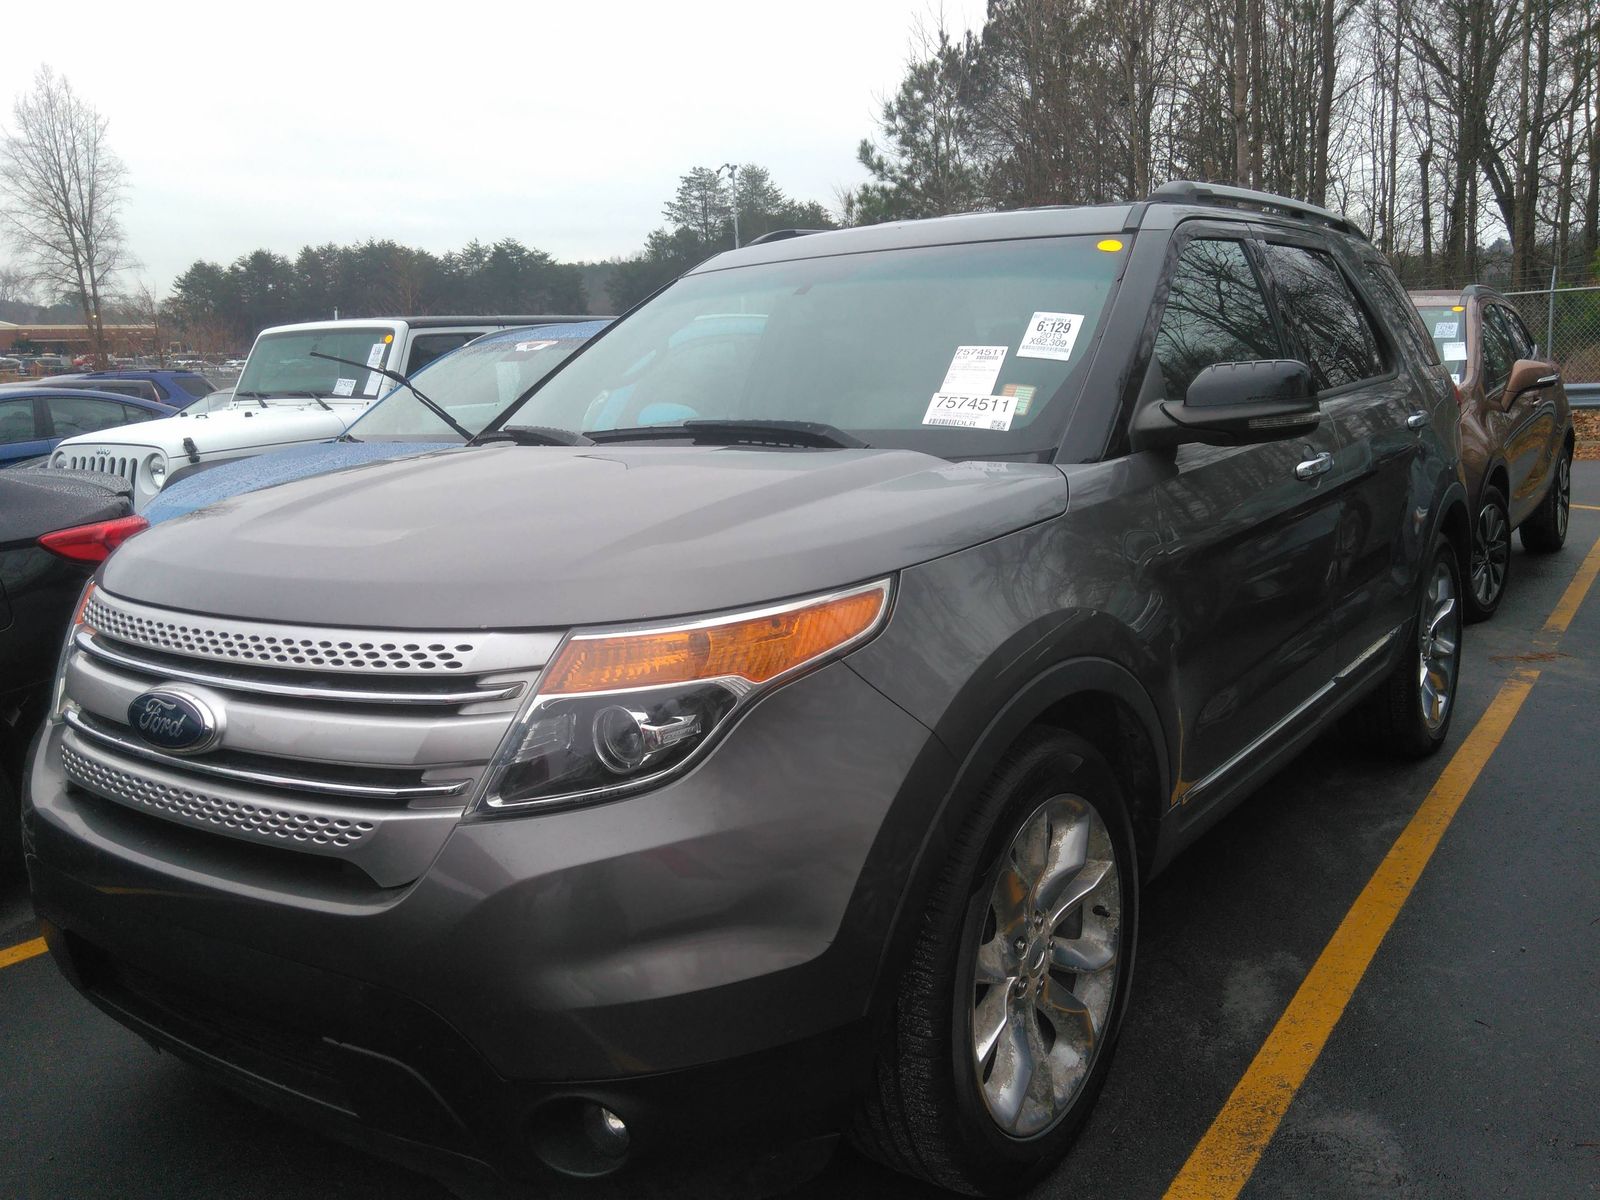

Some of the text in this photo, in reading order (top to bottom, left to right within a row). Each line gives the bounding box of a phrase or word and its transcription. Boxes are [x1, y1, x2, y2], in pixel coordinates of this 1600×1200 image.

[1036, 320, 1071, 334] 6:129
[1040, 331, 1062, 340] 2013
[956, 348, 1005, 356] 7574511
[936, 396, 1009, 413] 7574511
[139, 698, 186, 737] Ford
